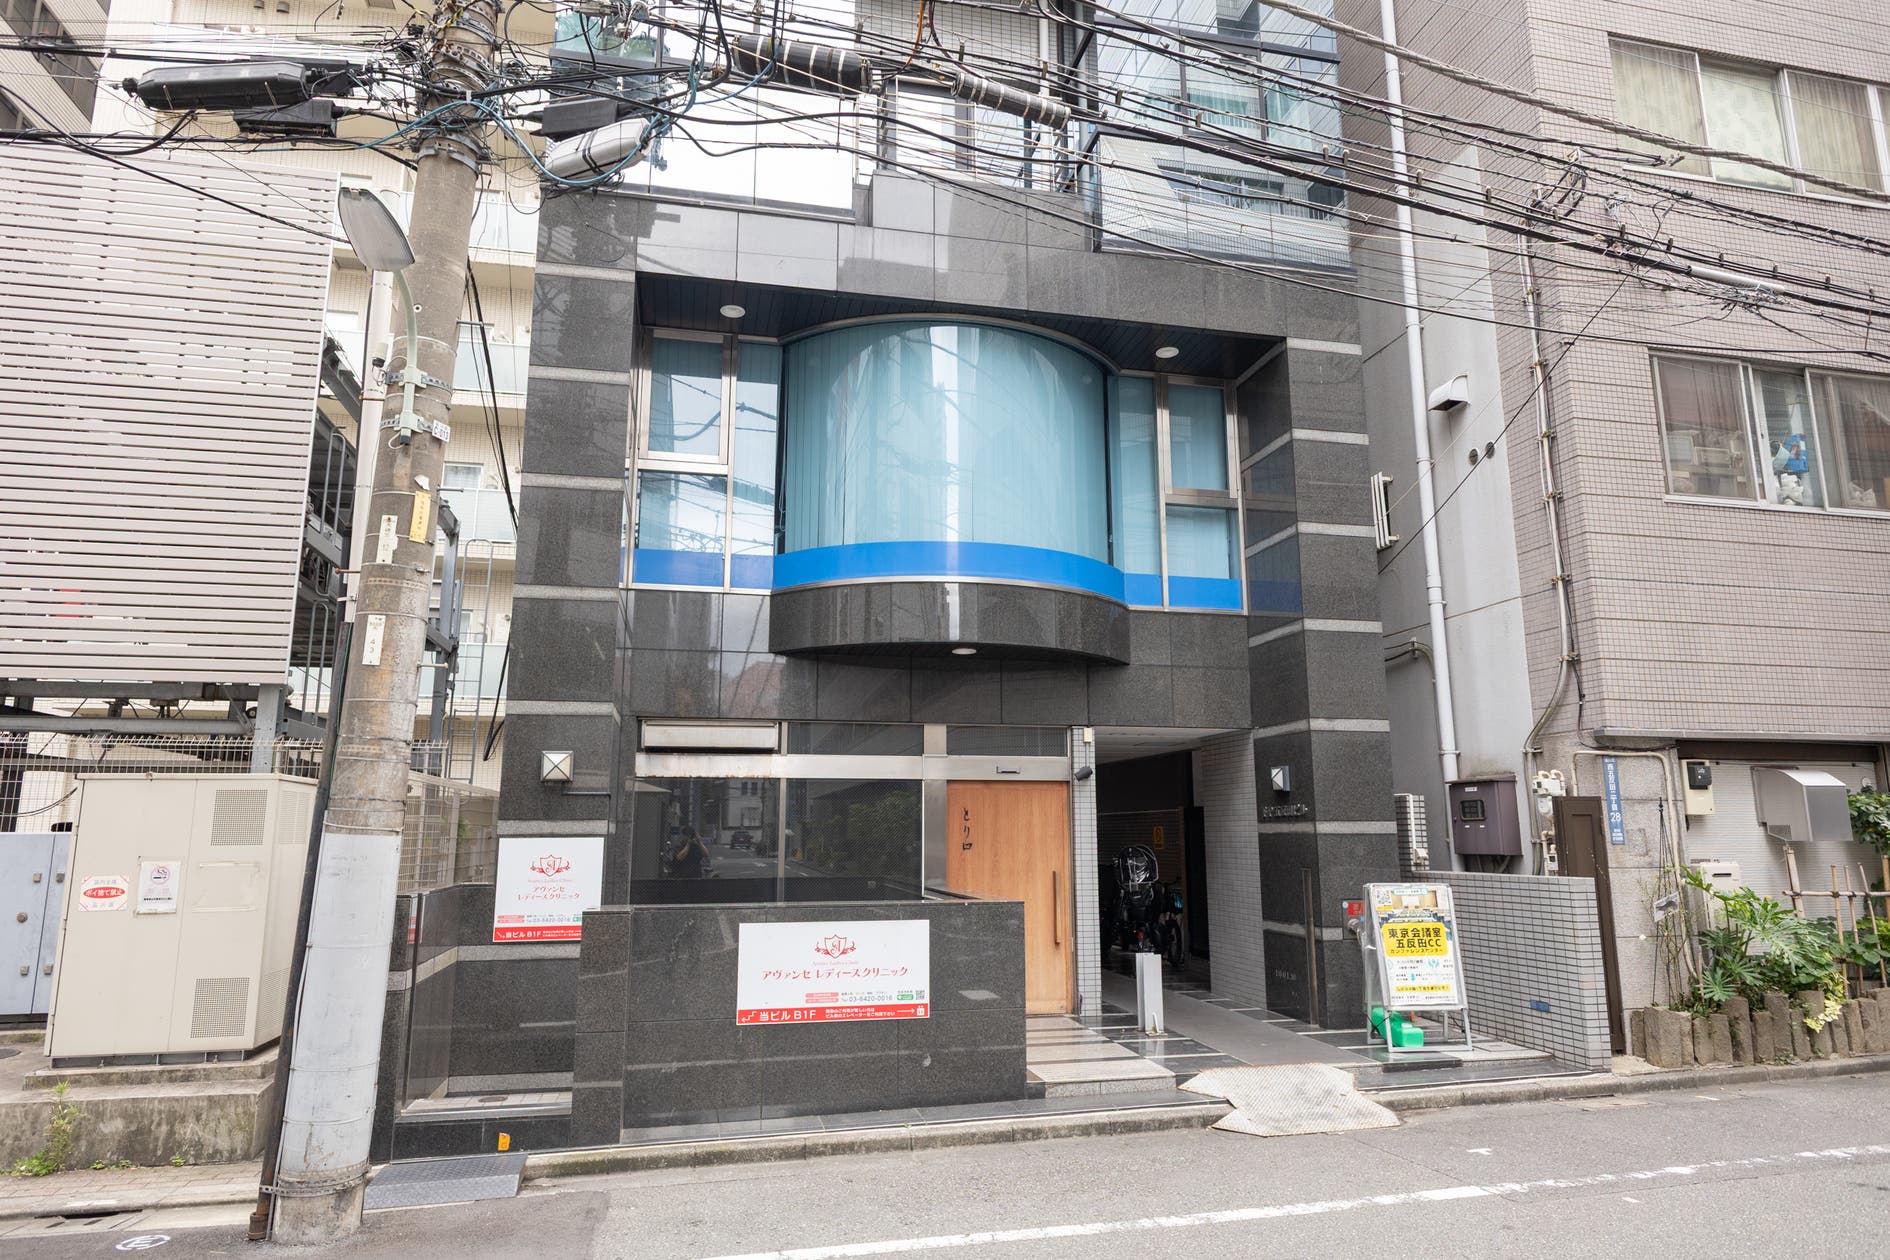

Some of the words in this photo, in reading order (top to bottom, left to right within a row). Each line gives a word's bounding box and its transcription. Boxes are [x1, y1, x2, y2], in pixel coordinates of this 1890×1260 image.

[1609, 812, 1621, 822] 28
[1388, 927, 1442, 938] 東京会議室
[1396, 939, 1442, 949] 五反田CC
[762, 969, 812, 981] アヴァンセ
[815, 966, 909, 979] レディースクリニック
[759, 1010, 791, 1022] 当ビル
[793, 1009, 817, 1020] B1F
